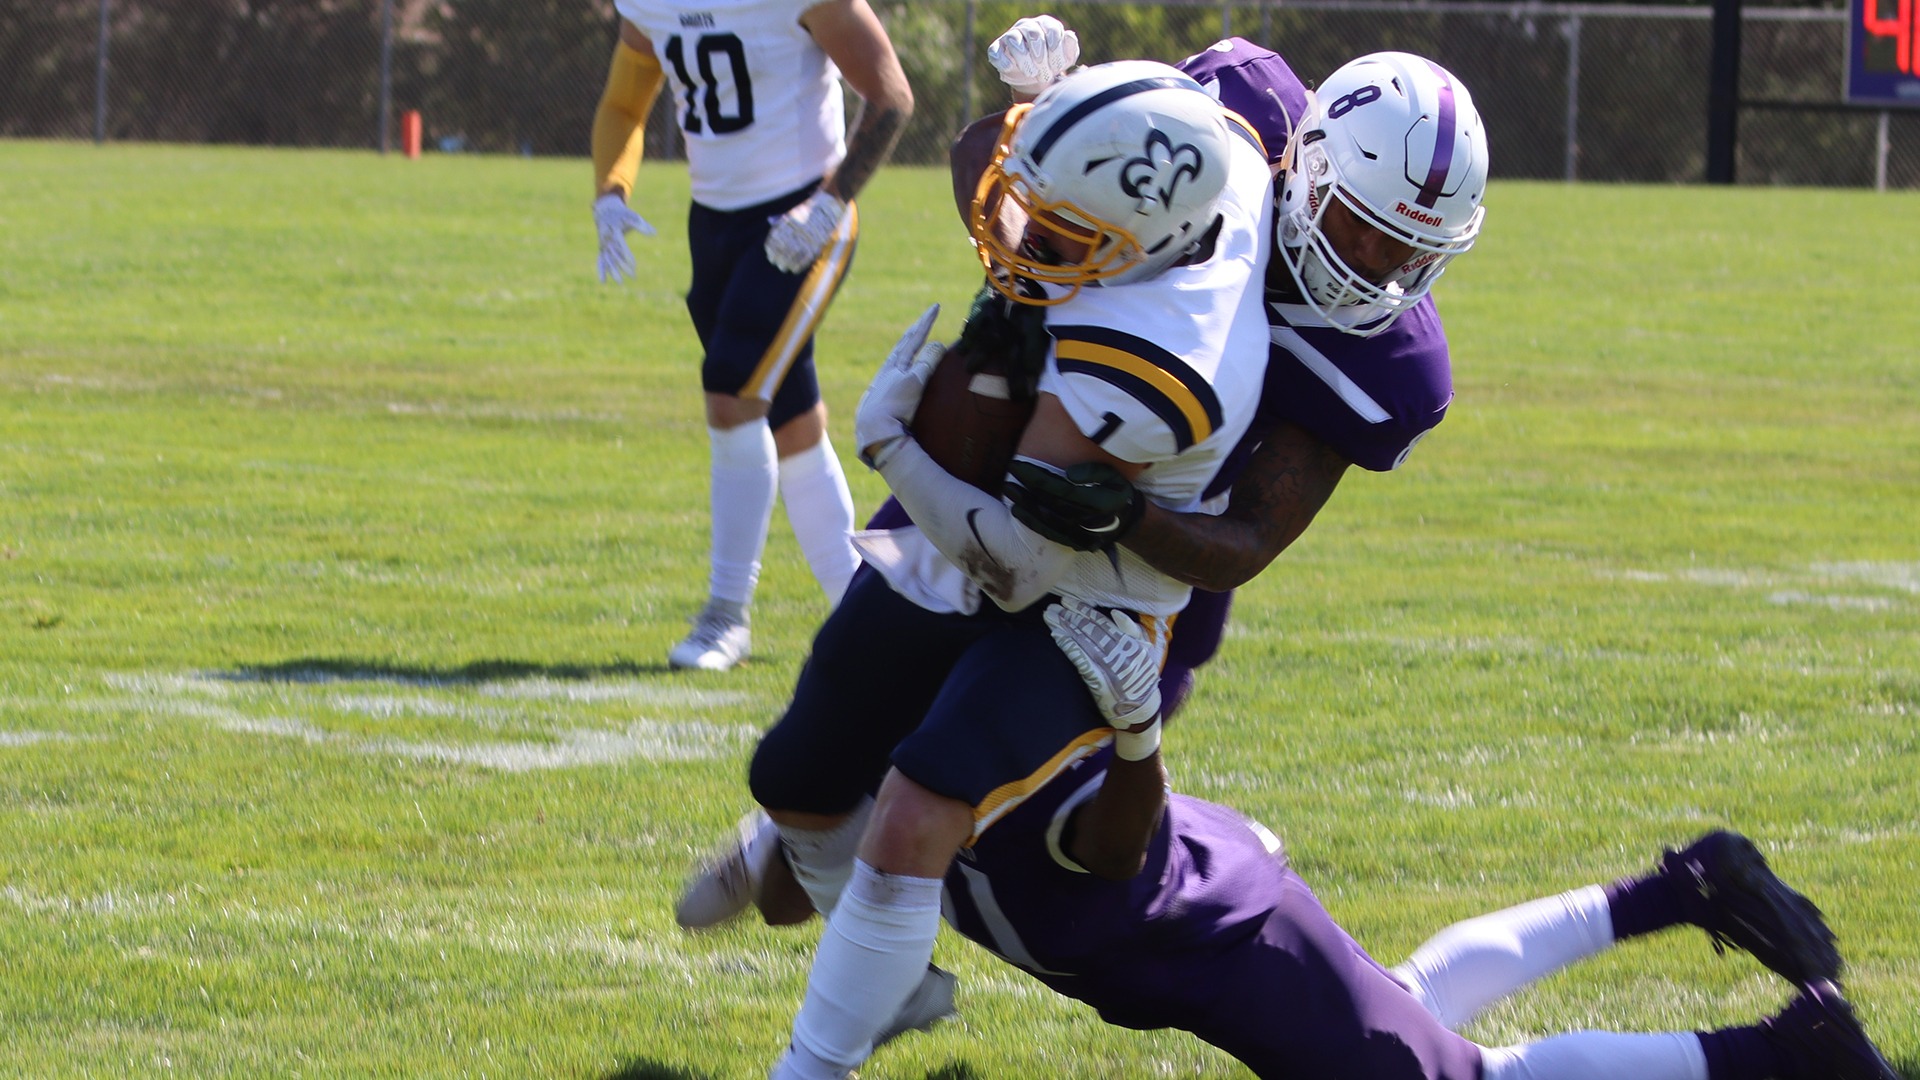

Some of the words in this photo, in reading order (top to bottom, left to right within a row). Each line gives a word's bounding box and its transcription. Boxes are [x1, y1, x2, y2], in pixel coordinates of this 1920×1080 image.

[1863, 0, 1920, 77] 4
[665, 33, 755, 136] 10
[1327, 84, 1382, 119] 8
[1309, 180, 1319, 220] Ridde
[1395, 202, 1443, 227] Riddell
[1089, 411, 1127, 444] 1
